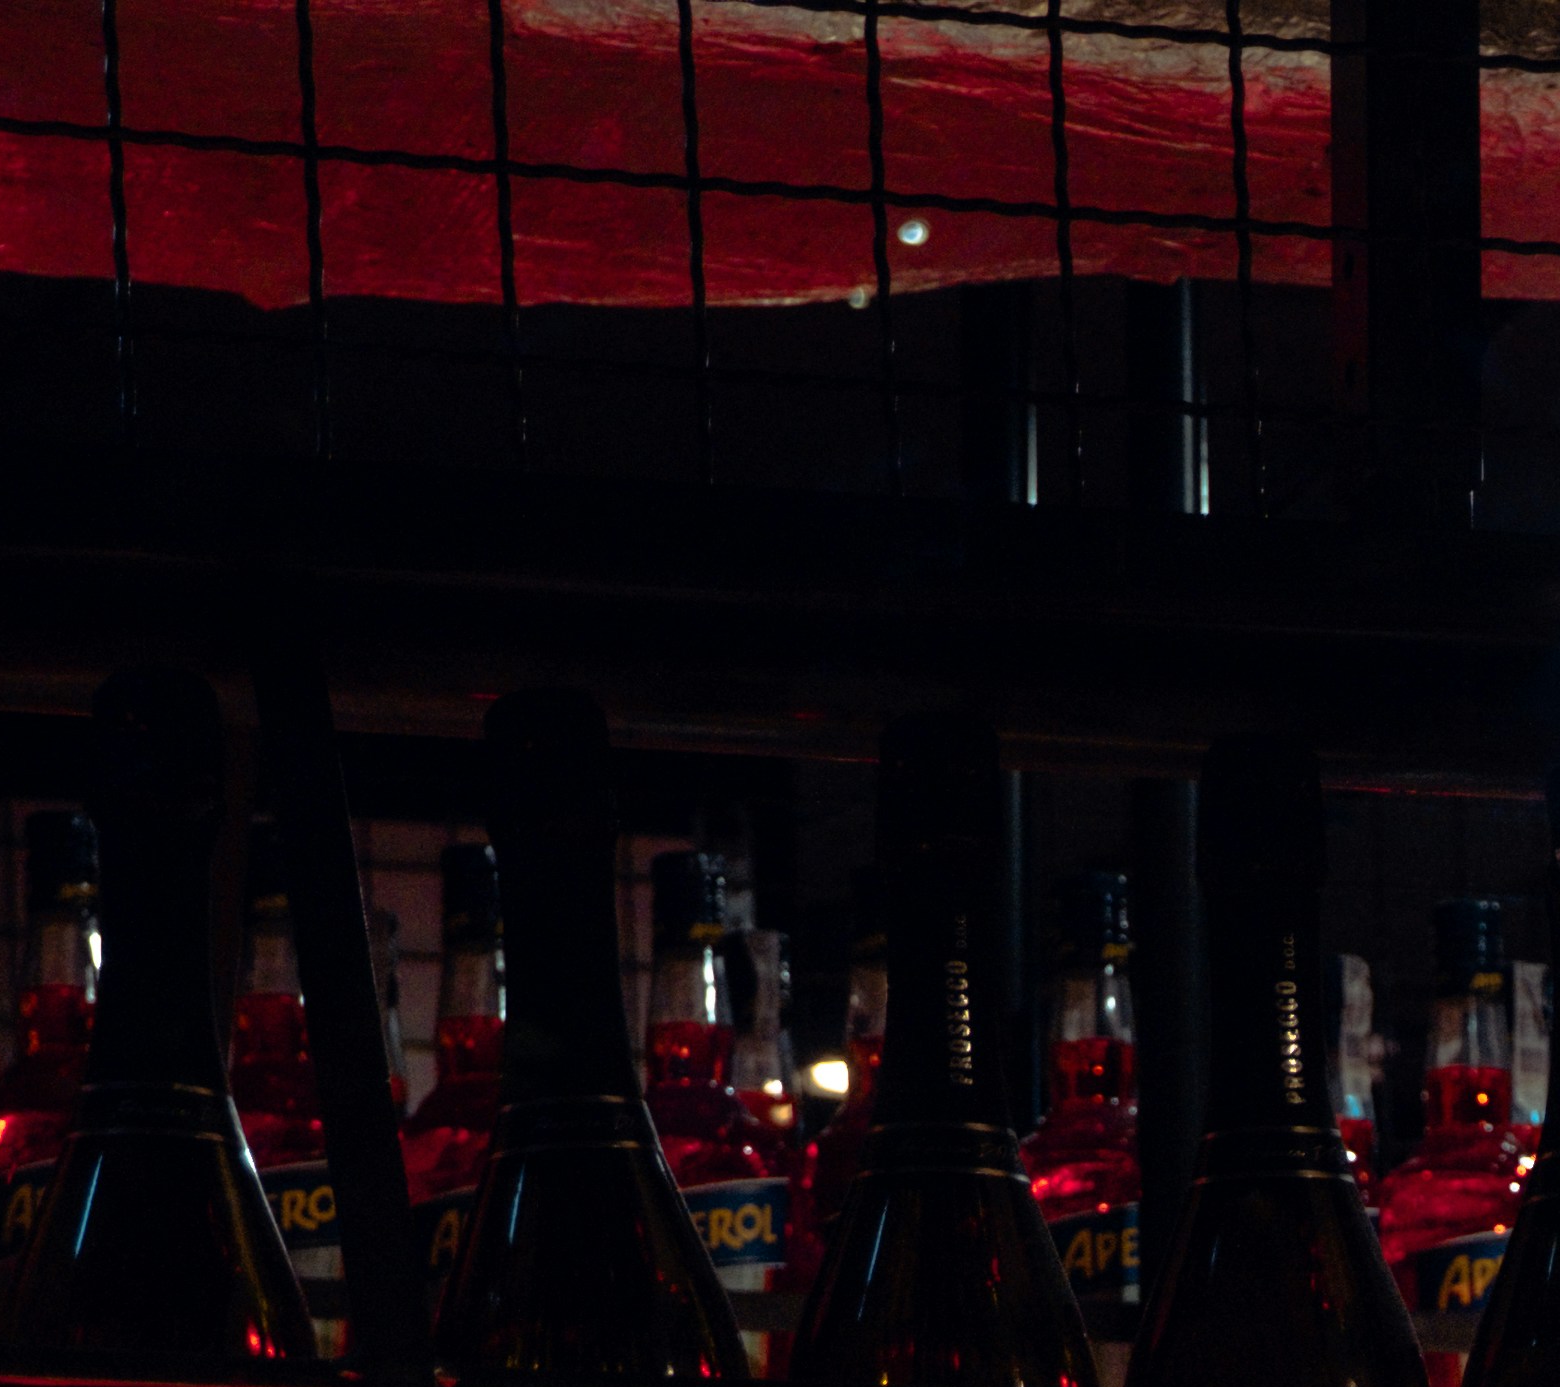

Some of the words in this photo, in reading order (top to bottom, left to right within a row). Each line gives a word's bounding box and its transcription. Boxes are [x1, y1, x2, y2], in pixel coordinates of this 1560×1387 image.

[948, 960, 974, 1087] PROSECCO
[1274, 981, 1306, 1105] PROSECCO
[694, 1204, 777, 1252] EROL
[1061, 1227, 1141, 1282] APE
